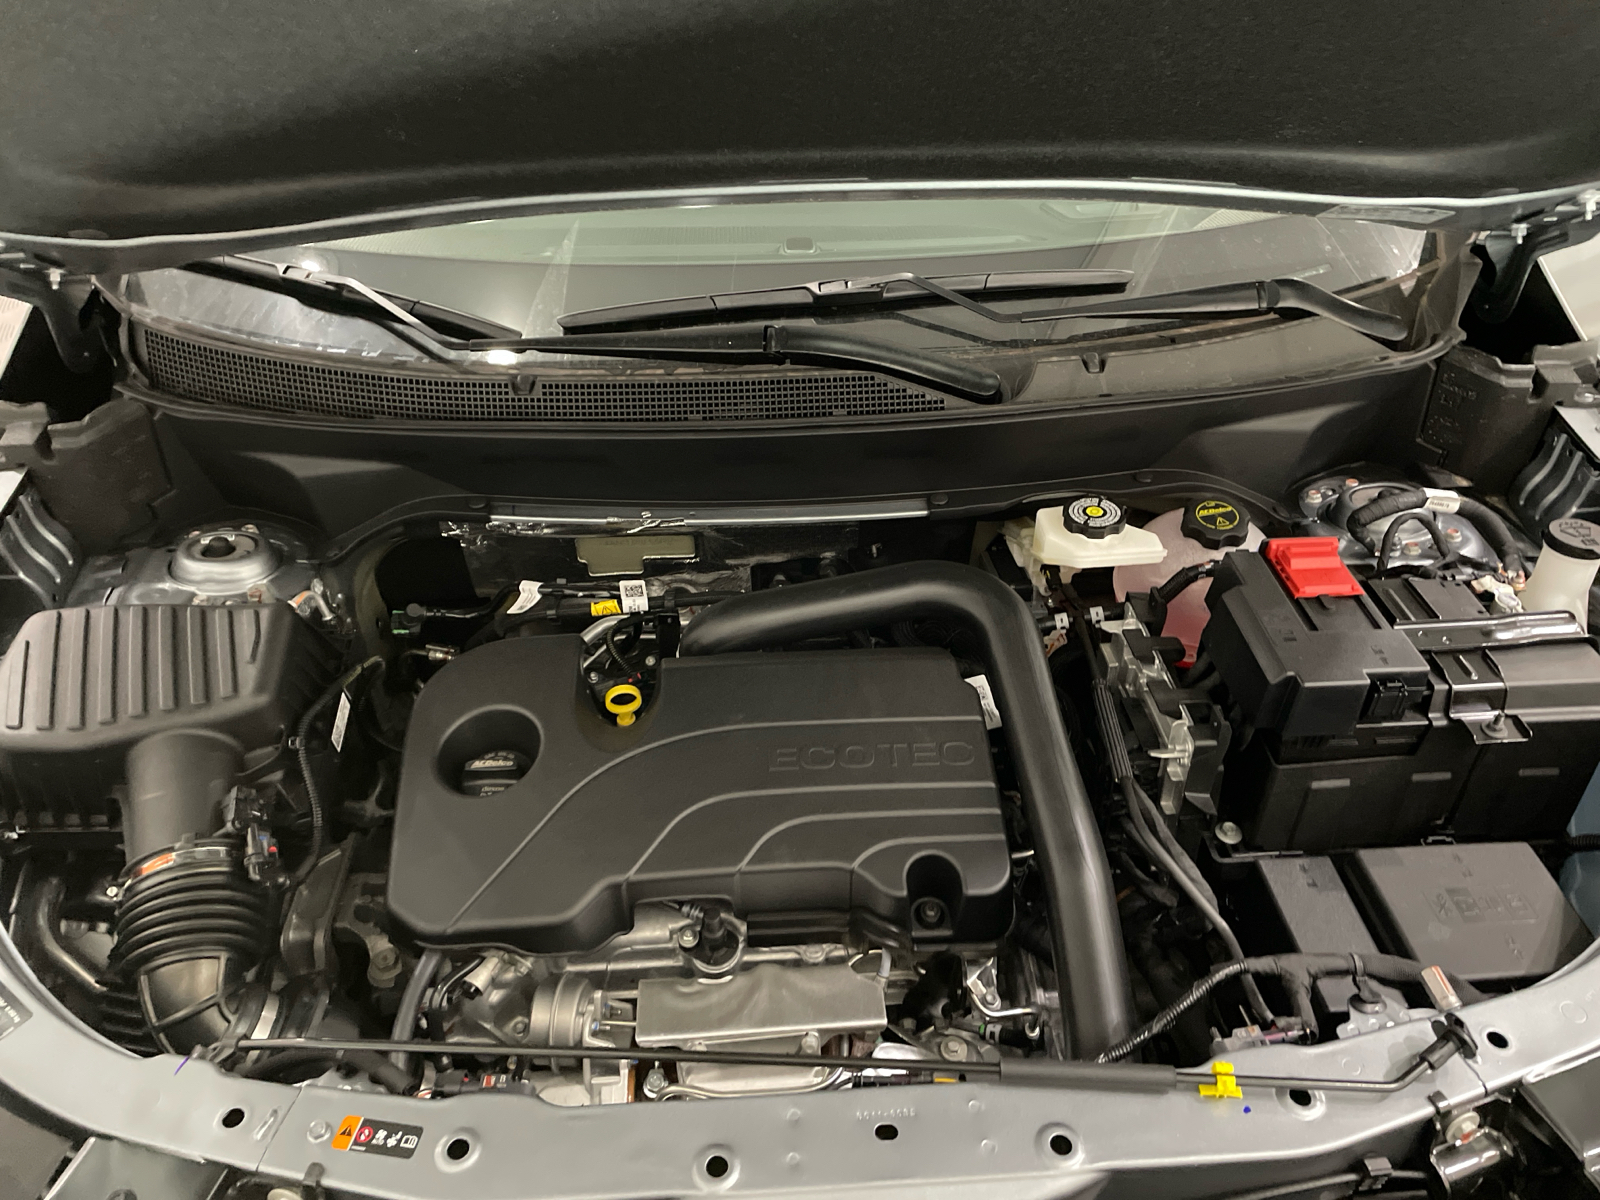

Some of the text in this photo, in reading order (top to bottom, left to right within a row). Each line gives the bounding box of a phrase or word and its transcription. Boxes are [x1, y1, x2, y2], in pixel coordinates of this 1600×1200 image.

[1199, 506, 1232, 517] ACDelco
[769, 742, 975, 772] ECOTEC
[470, 760, 514, 769] ACDelco
